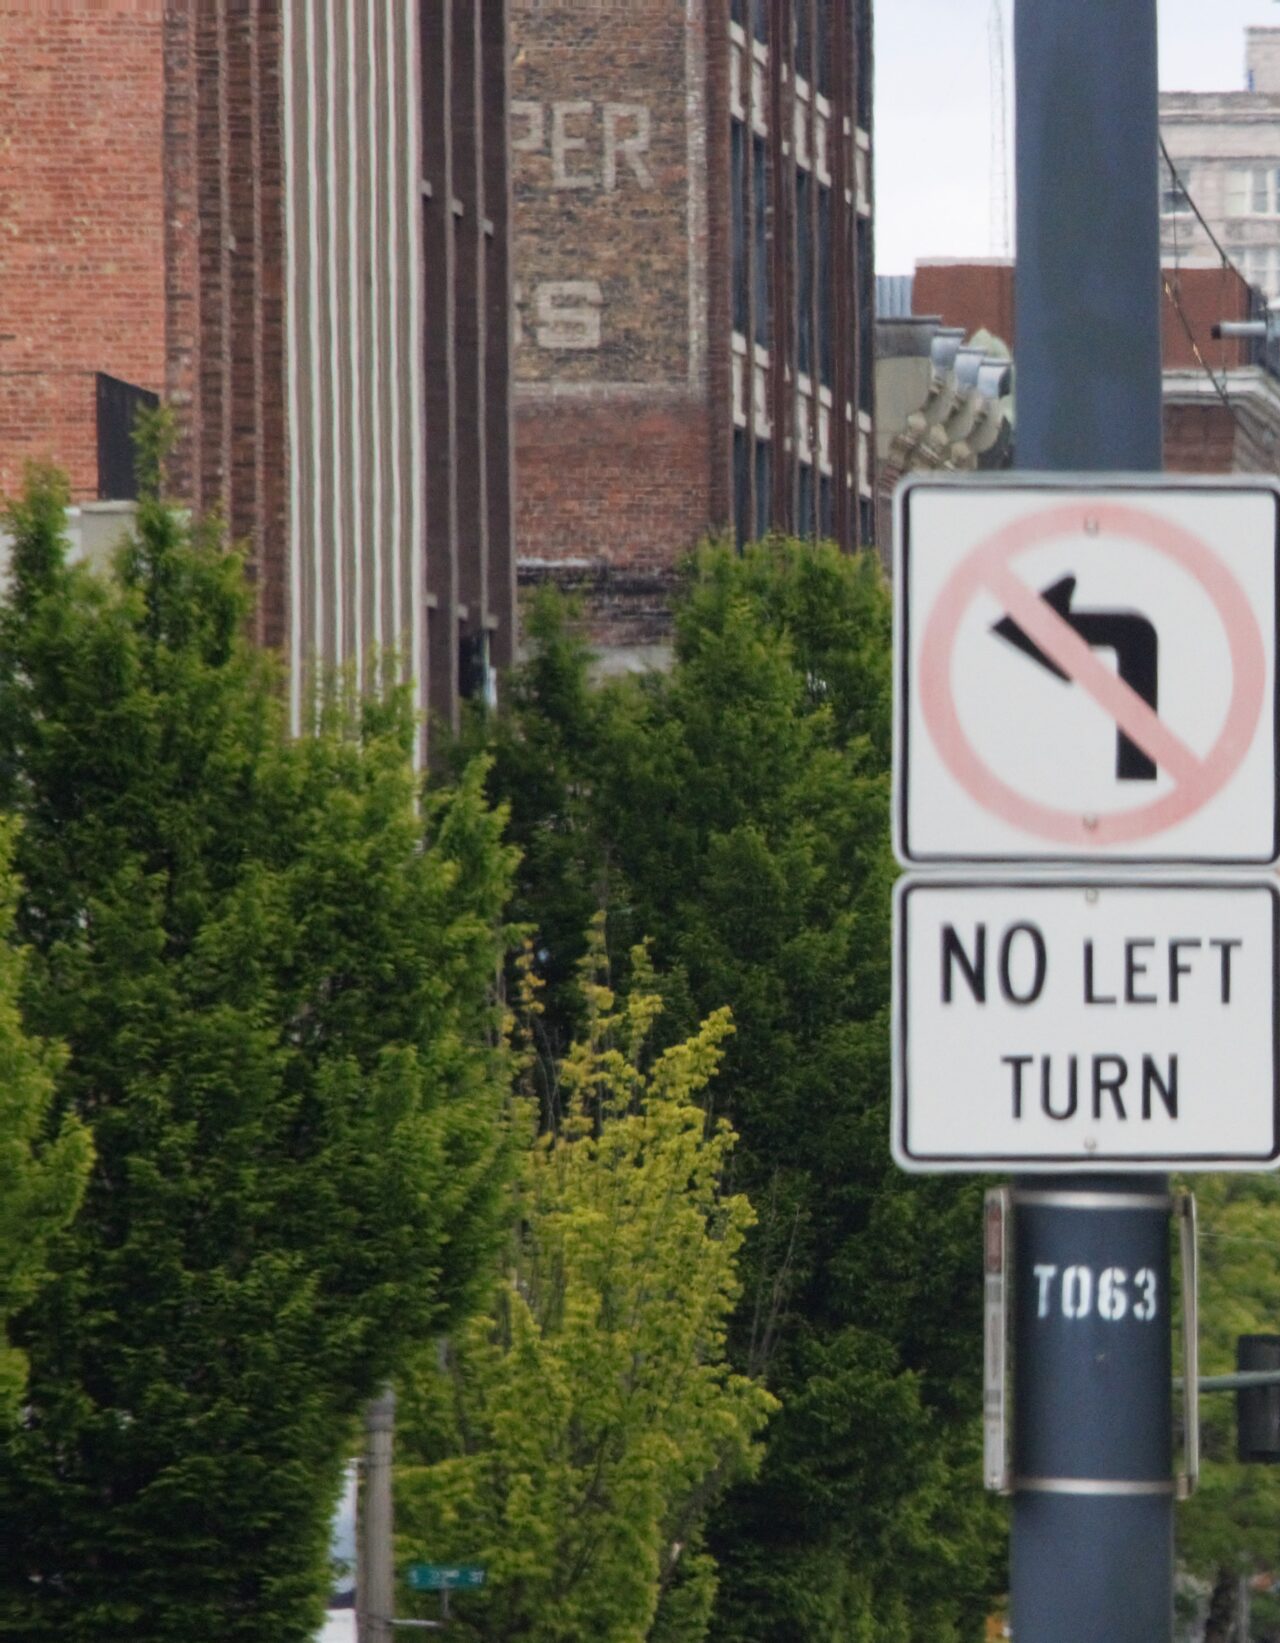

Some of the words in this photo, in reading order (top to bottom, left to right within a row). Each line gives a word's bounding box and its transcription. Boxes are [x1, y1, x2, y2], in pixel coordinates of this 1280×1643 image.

[940, 920, 1047, 1006] NO
[1082, 936, 1243, 1004] LEFT
[1001, 1053, 1180, 1121] TURN
[1033, 1263, 1158, 1322] T063
